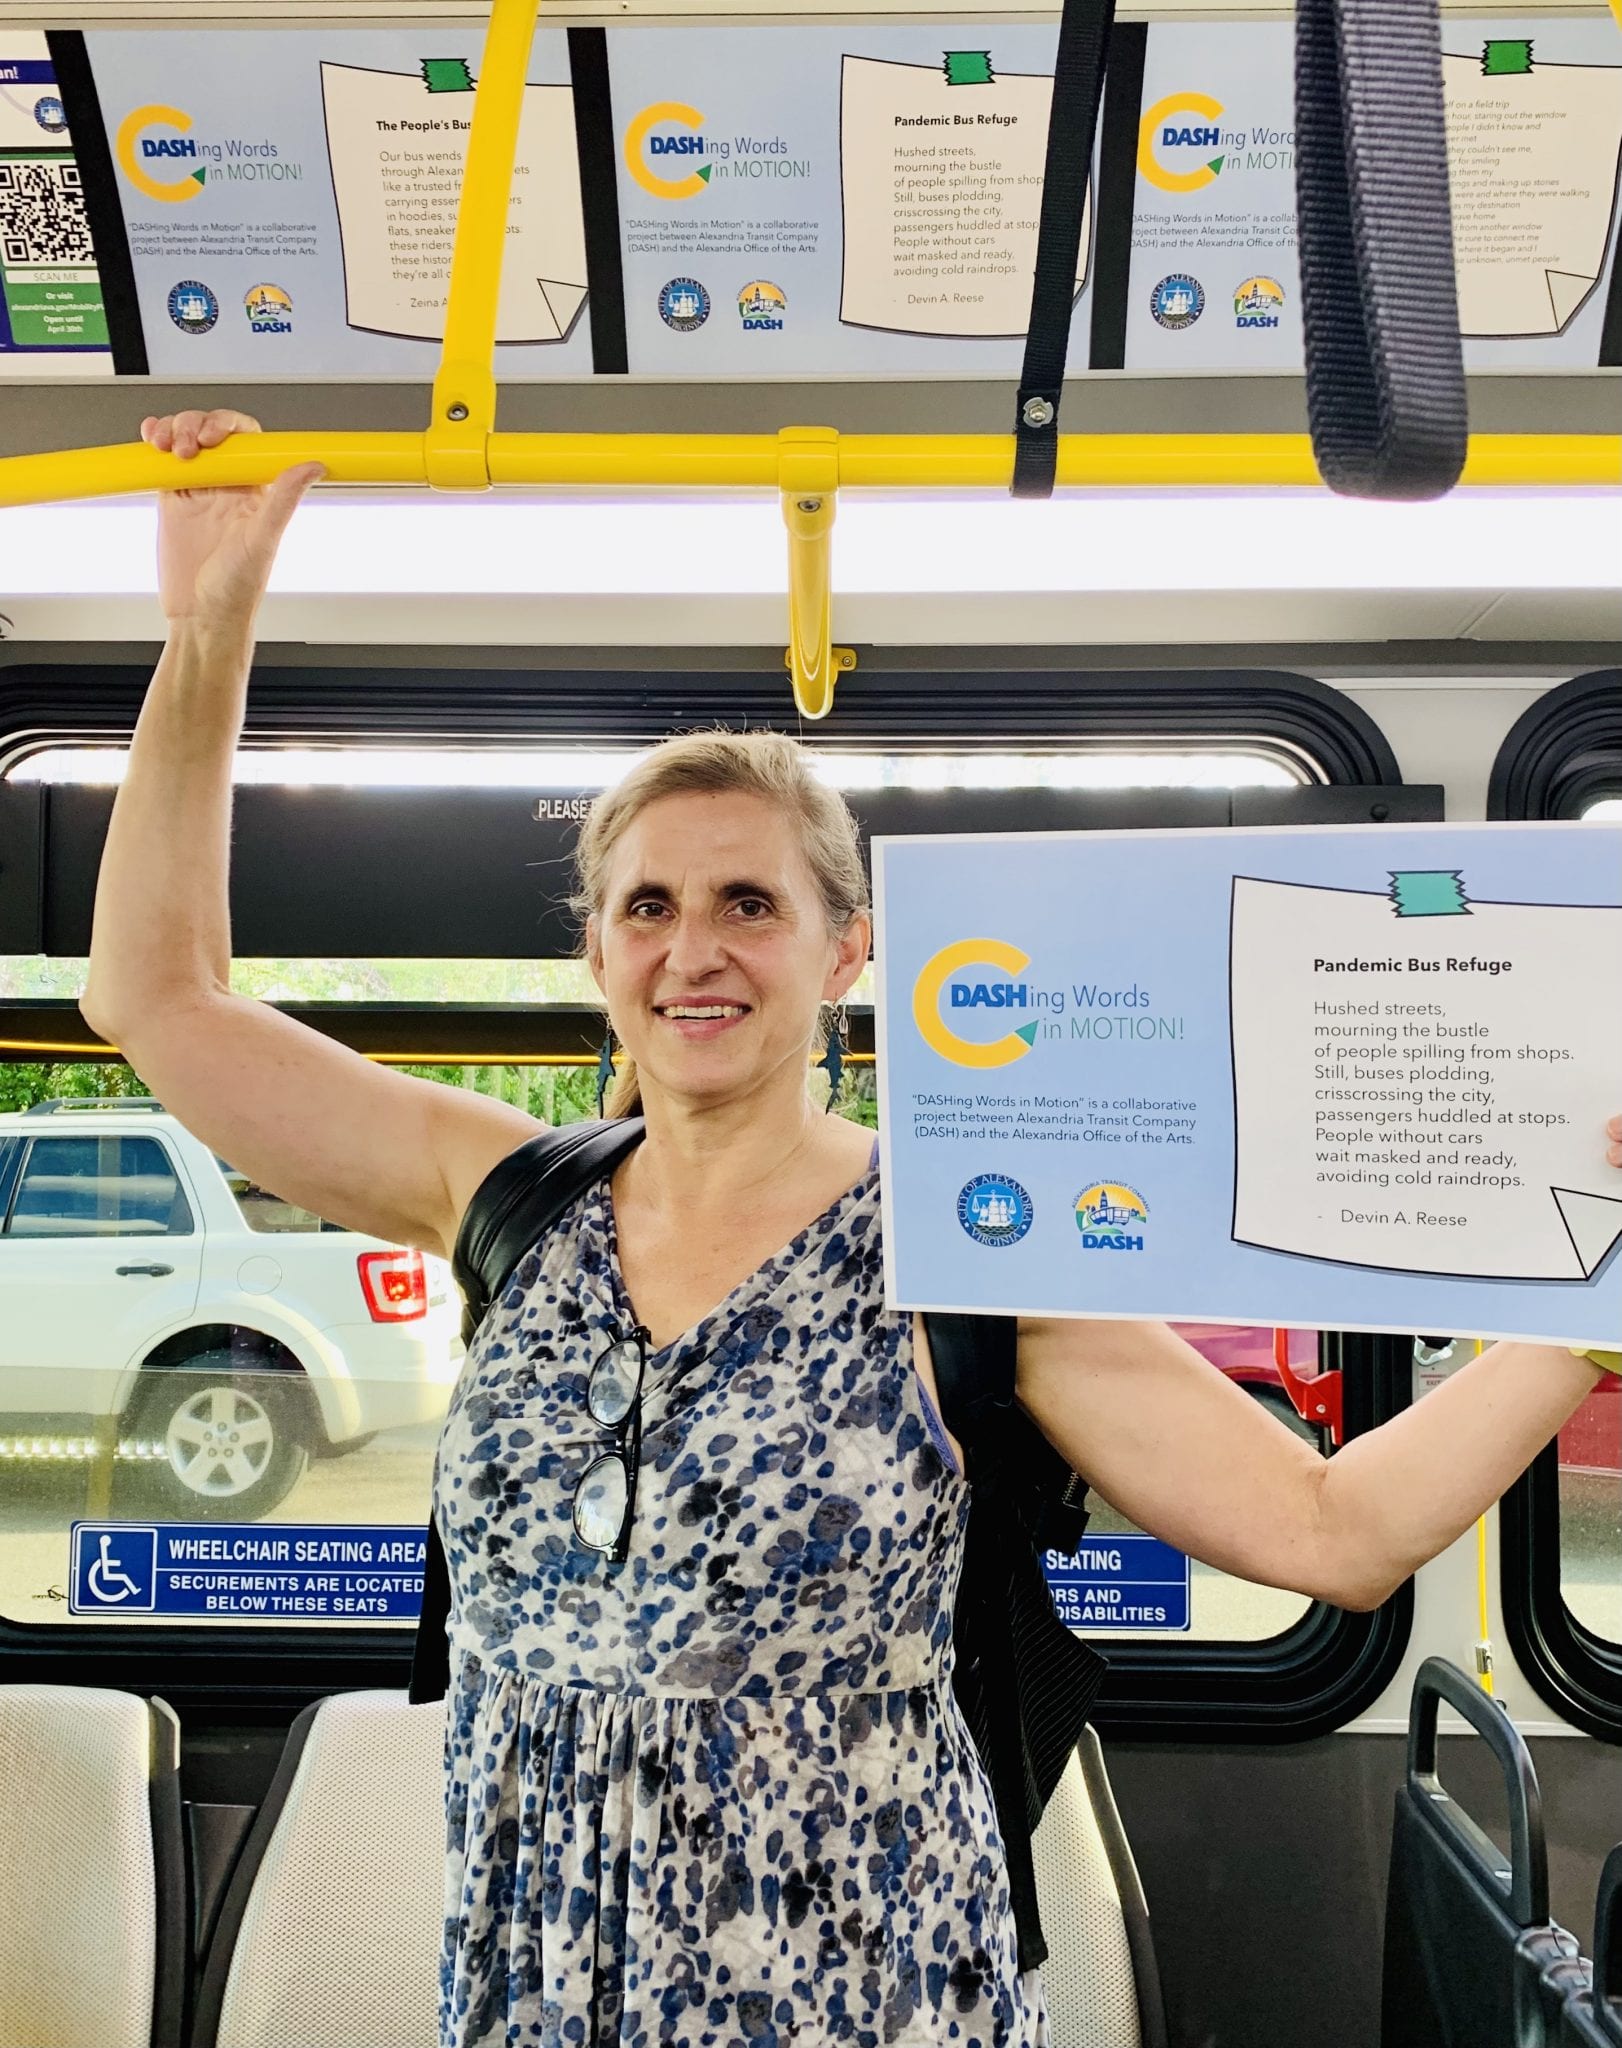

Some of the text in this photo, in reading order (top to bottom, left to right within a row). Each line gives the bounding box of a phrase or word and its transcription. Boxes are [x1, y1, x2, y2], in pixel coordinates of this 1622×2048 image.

[894, 114, 1018, 127] Pandemic Bus Refuge
[735, 137, 788, 154] Words
[894, 146, 936, 157] Hushed
[715, 160, 810, 178] in MOTION!
[894, 160, 1002, 174] mourning the bustle
[1246, 152, 1293, 170] MOTI
[894, 174, 1044, 189] of people spilling from shop
[918, 192, 950, 202] buses
[893, 208, 961, 219] crisscrossing
[963, 206, 980, 216] the
[893, 220, 1040, 234] passengers huddled at stop
[893, 236, 996, 249] People without cars
[893, 253, 915, 262] wait
[917, 250, 958, 261] masked
[960, 249, 981, 260] and
[33, 272, 78, 281] SCAN ME
[893, 266, 939, 278] avoiding
[941, 264, 964, 275] cold
[907, 294, 938, 304] Devin
[953, 293, 985, 303] Reese
[252, 322, 292, 332] DASH
[742, 320, 783, 330] DASH
[1236, 316, 1278, 327] DASH
[538, 799, 588, 819] PLEASE
[1314, 957, 1513, 976] Pandemic Bus Refuge
[951, 984, 1150, 1013] DASHing Words
[1314, 1001, 1446, 1017] Hushed streets,
[1043, 1017, 1184, 1040] in MOTION!
[1314, 1022, 1489, 1041] mourning the bustle
[1314, 1042, 1574, 1063] of people spilling from shops.
[1315, 1064, 1494, 1085] Still, buses plodding,
[912, 1094, 1197, 1111] "DASHing Words in Motion" is a collaborative
[1315, 1087, 1495, 1106] crisscrossing the city,
[914, 1112, 1197, 1130] project between Alexandria Transit Company
[1316, 1108, 1570, 1128] passengers huddled at stops.
[915, 1126, 1196, 1144] (DASH) and the Alexandria Office of the Arts.
[1316, 1127, 1483, 1145] People without cars
[1315, 1149, 1517, 1169] wait masked and ready,
[1316, 1169, 1525, 1189] avoiding cold raindrops.
[981, 1174, 1033, 1221] ALEXANDRIA
[1341, 1209, 1468, 1226] Devin A. Reese
[971, 1228, 1022, 1247] VIRGINIA
[1082, 1234, 1144, 1250] DASH
[169, 1540, 427, 1563] WHEELCHAIR SEATING AREA
[1046, 1549, 1122, 1571] SEATING
[170, 1575, 425, 1593] SECUREMENTS ARE LOCATED
[206, 1596, 388, 1612] BELOW THESE SEATS
[1084, 1589, 1122, 1604] AND
